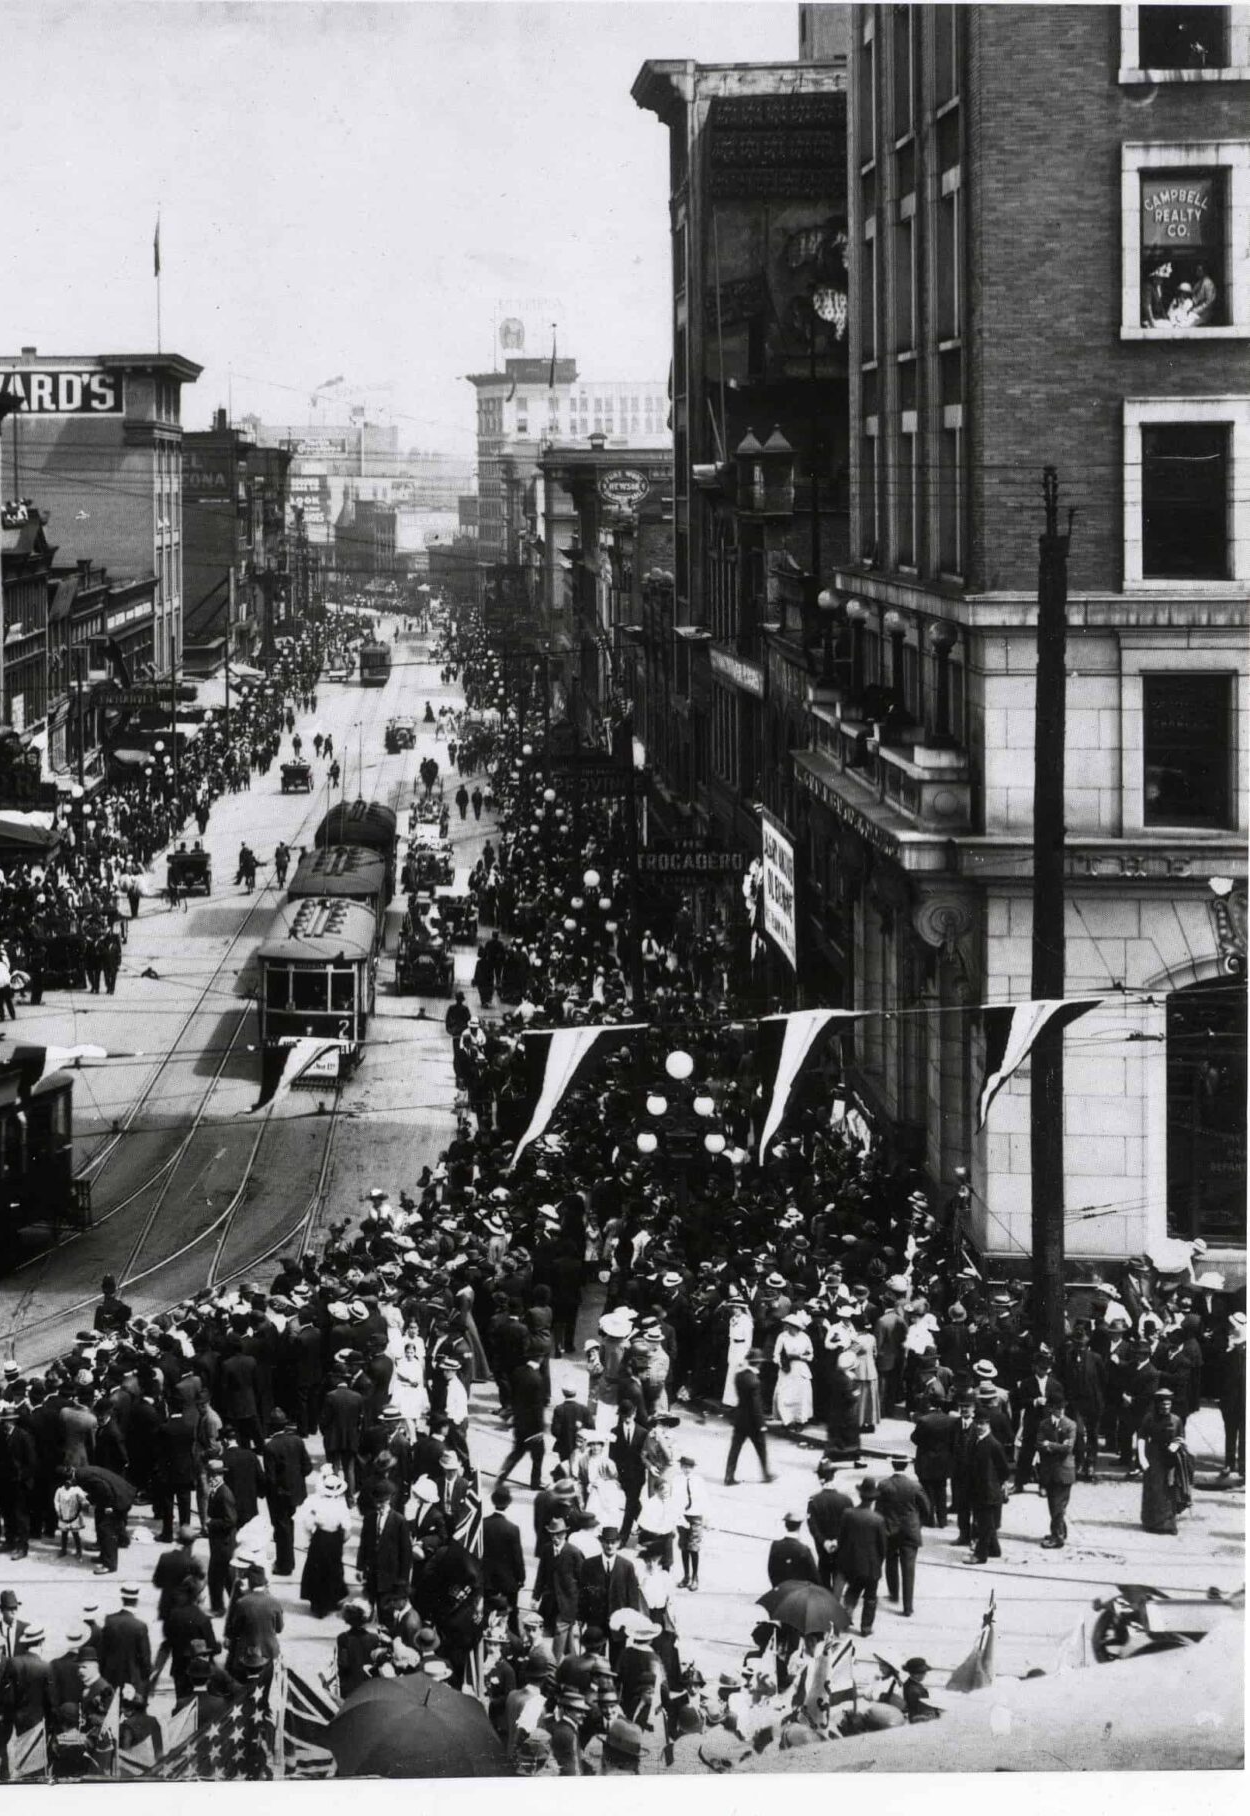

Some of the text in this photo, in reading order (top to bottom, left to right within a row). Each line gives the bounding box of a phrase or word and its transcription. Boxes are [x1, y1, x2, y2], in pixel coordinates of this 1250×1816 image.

[1144, 188, 1209, 211] CAMPBELL
[1155, 208, 1202, 222] REALTY
[1167, 223, 1190, 237] CO.
[1078, 856, 1192, 877] THE
[338, 1020, 350, 1040] 2
